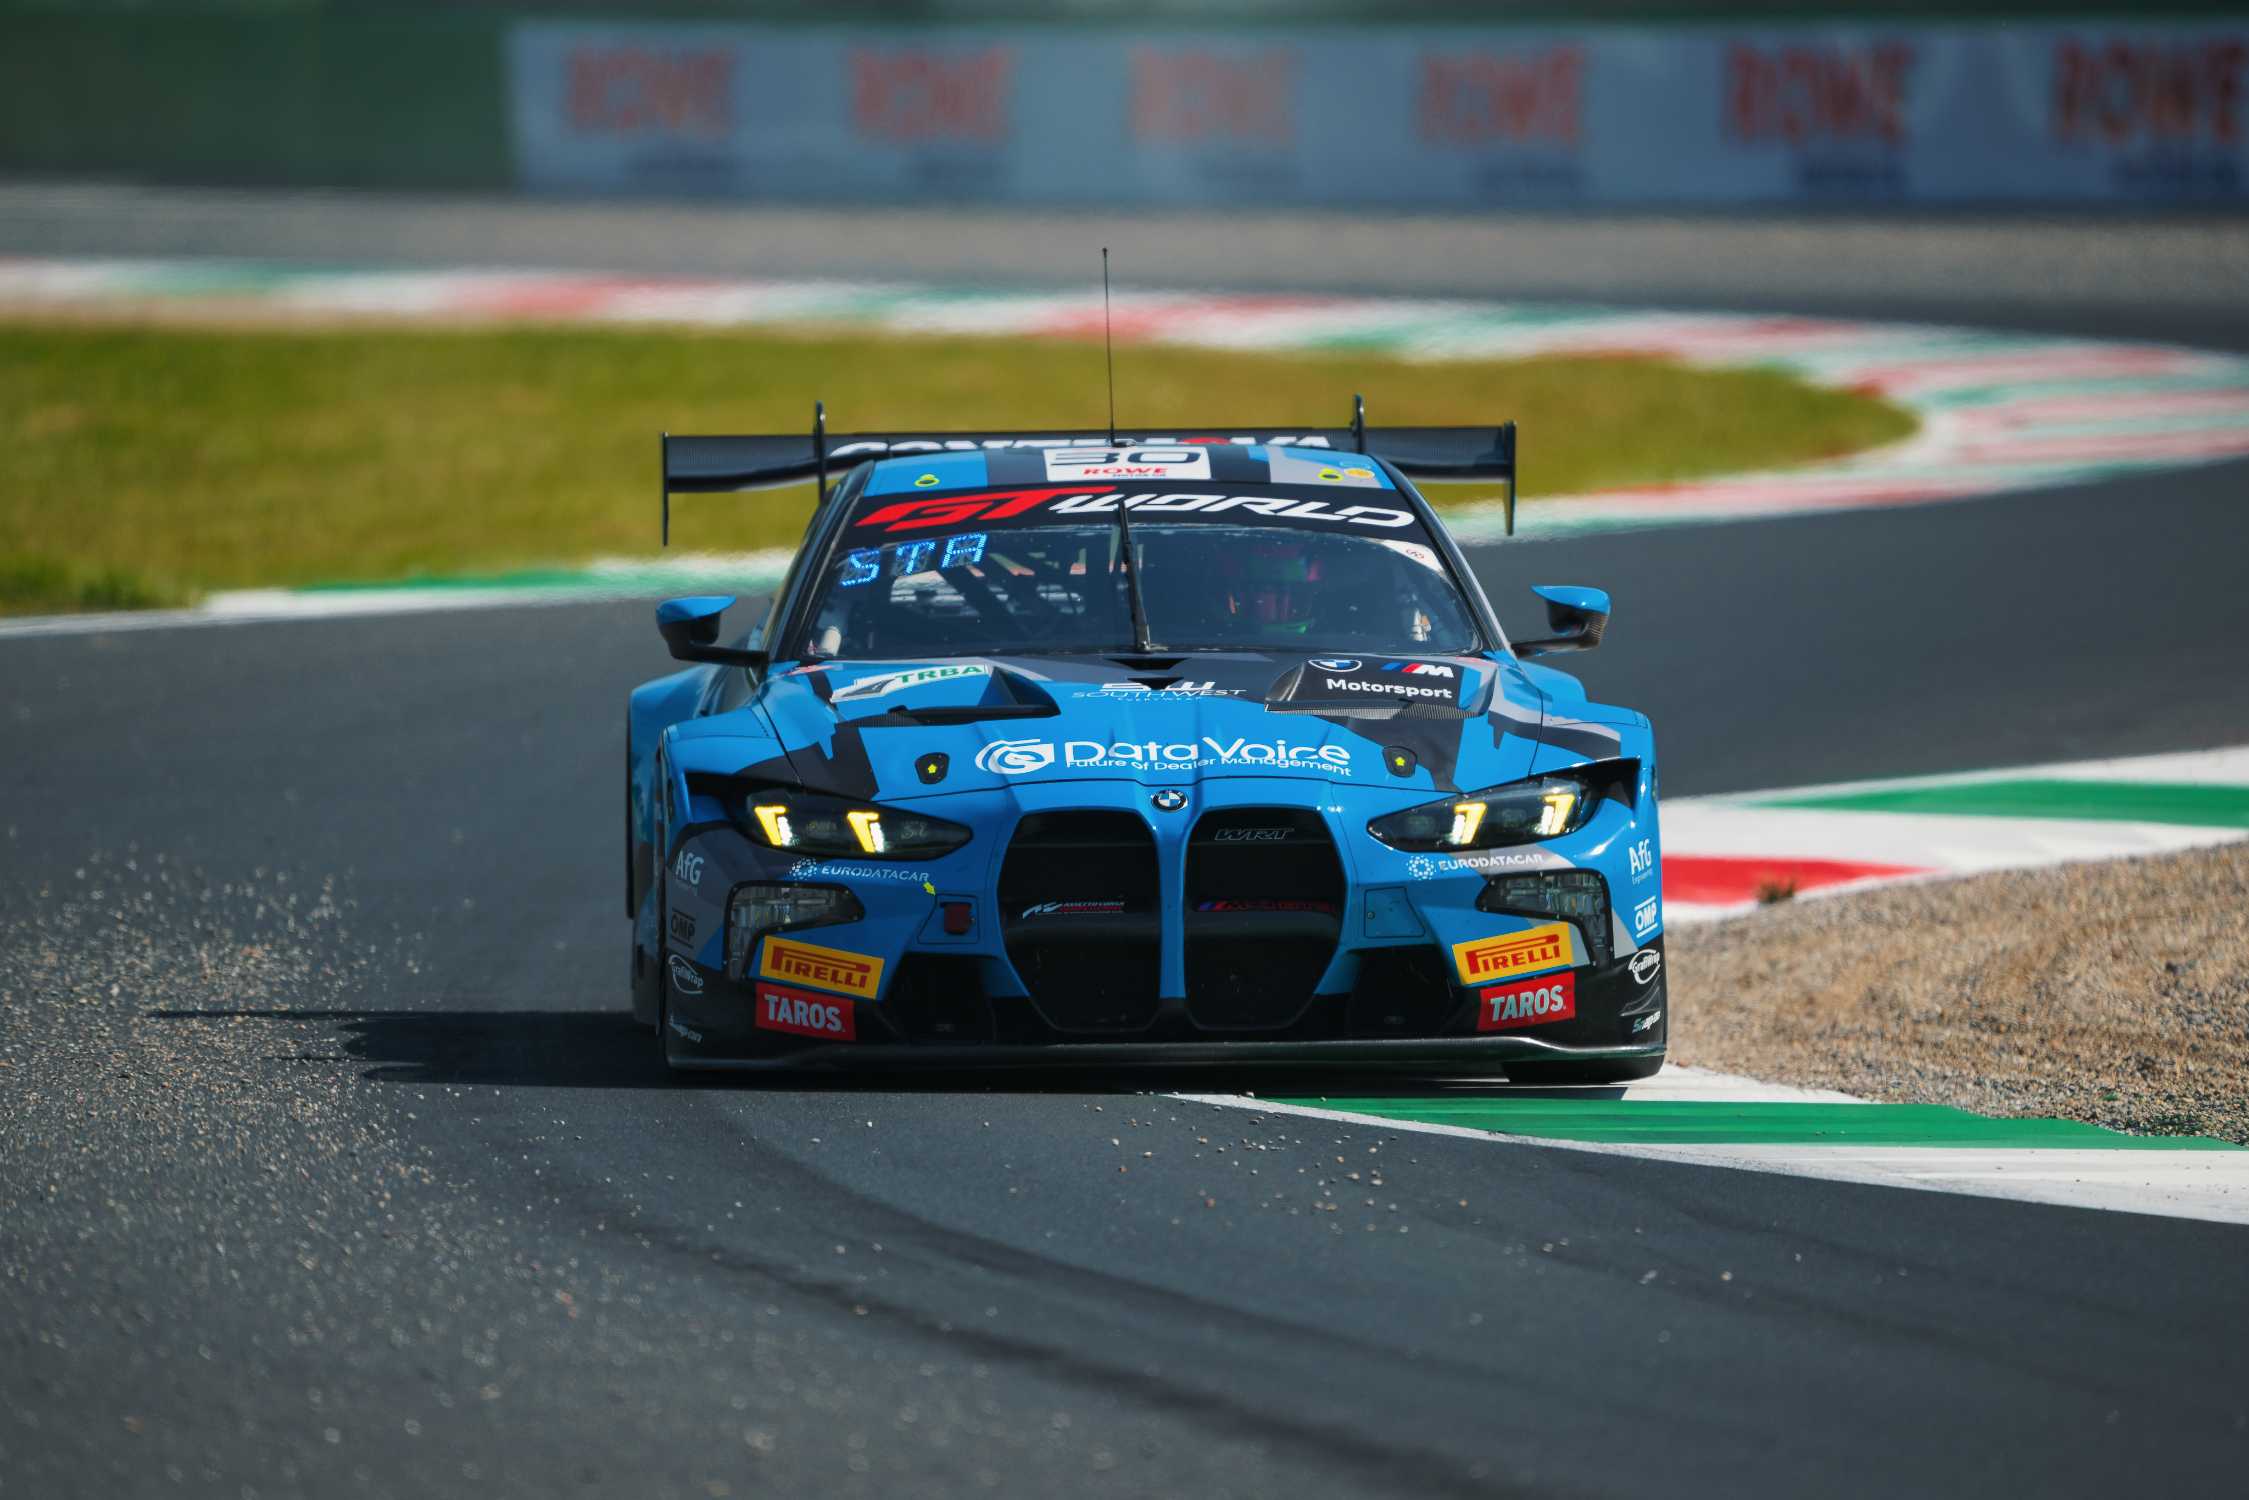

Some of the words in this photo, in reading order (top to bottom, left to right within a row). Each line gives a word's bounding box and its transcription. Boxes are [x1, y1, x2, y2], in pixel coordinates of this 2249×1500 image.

[1050, 452, 1200, 465] 30
[854, 486, 1117, 532] GT
[1048, 493, 1416, 528] WORLD
[840, 532, 988, 587] STA
[893, 666, 983, 685] TRBA
[1326, 678, 1453, 699] Motorsport
[1072, 689, 1247, 699] SOUTHWEST
[1066, 758, 1125, 768] Future
[1130, 760, 1148, 770] of
[1154, 758, 1215, 770] Dealer
[1220, 757, 1352, 776] Management
[675, 850, 705, 885] AfG
[821, 864, 930, 882] EURODATACAR
[1438, 853, 1545, 872] EURODATACAR
[1634, 902, 1658, 931] OMP
[771, 945, 872, 989] PIRELLI
[1465, 934, 1560, 975] PIRELLI
[764, 993, 846, 1033] TAROS
[1489, 984, 1566, 1023] TAROS
